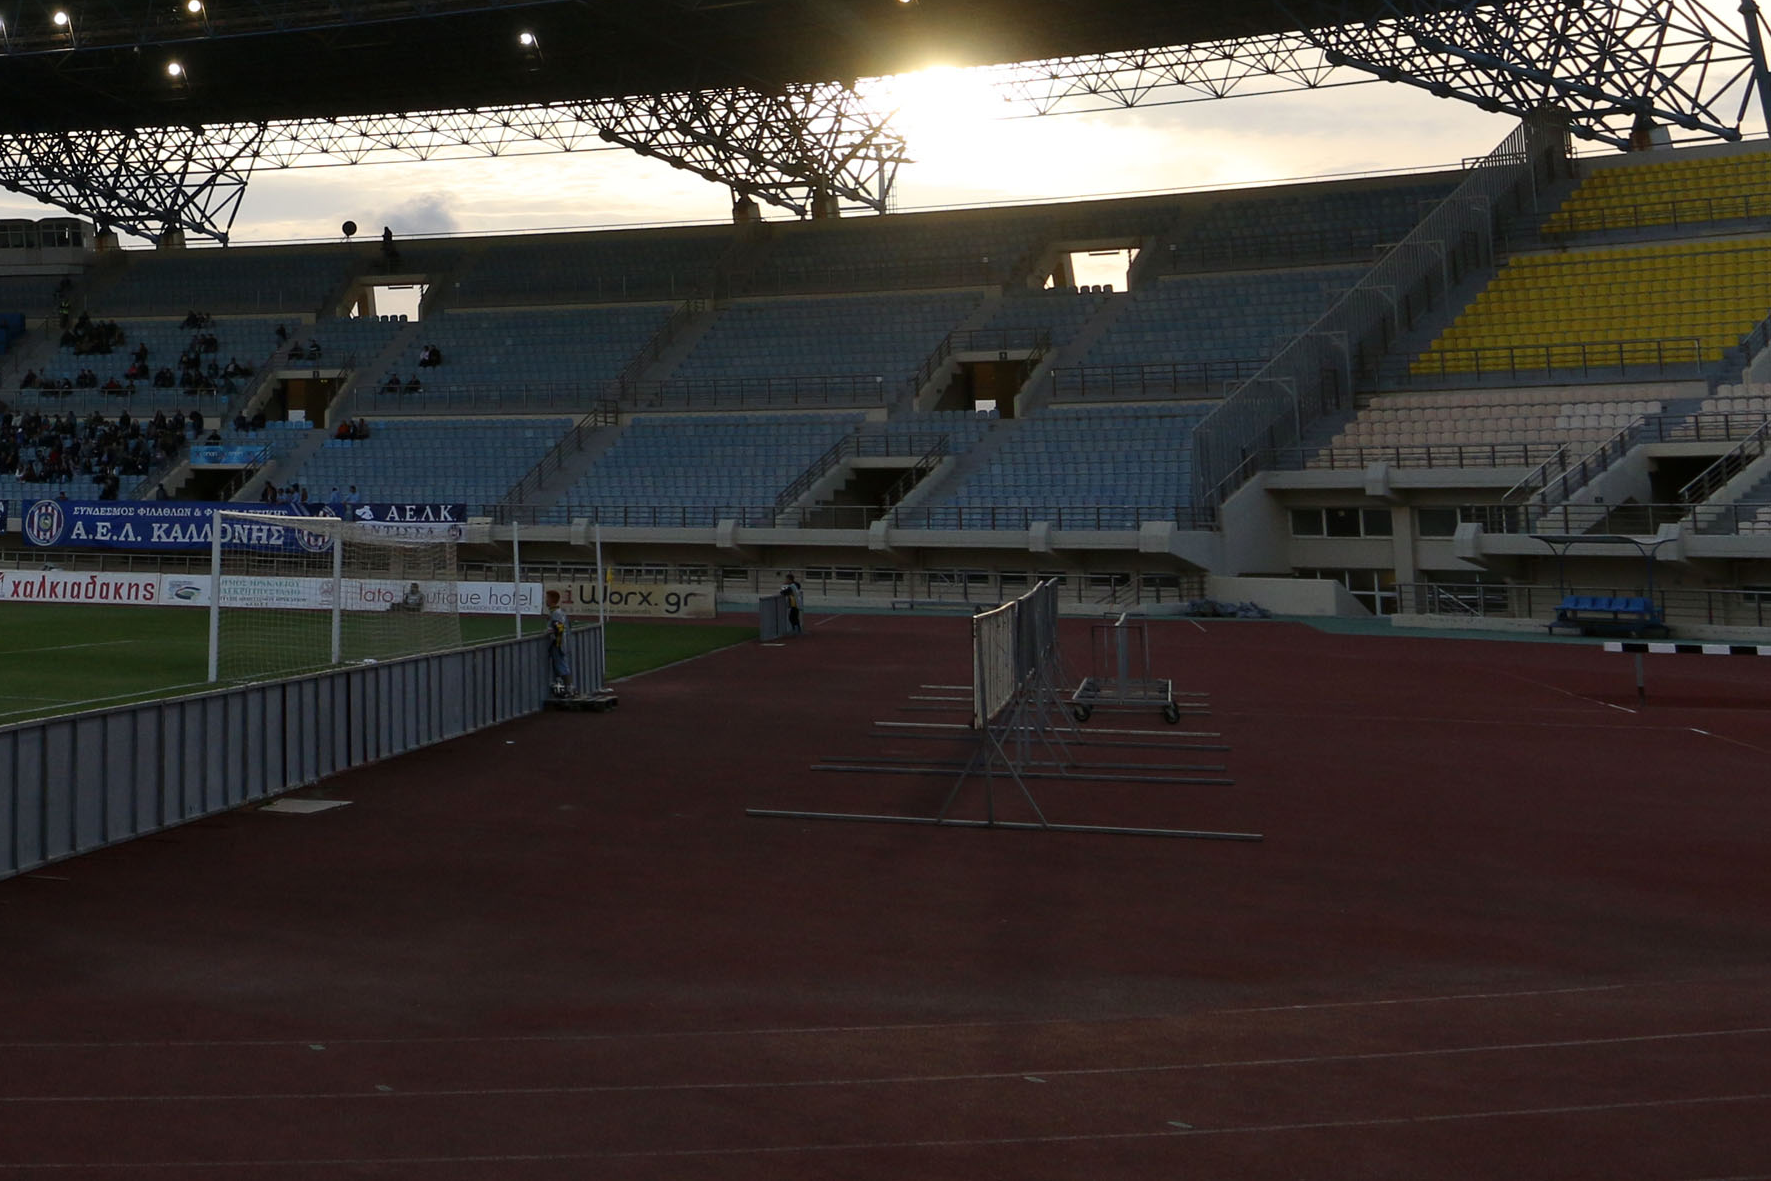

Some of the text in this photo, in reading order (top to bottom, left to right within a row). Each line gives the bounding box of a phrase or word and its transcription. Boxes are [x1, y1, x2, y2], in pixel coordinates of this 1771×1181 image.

[73, 506, 135, 516] ΣΥΝΔΕΣΜΟΣ
[137, 507, 191, 517] ΦΙΛΑΘΛΩΝ
[194, 508, 202, 517] &
[70, 520, 285, 545] Α.Ε.Λ. ΚΑΛΛΟΝΗΣ
[359, 582, 395, 603] lato
[488, 586, 533, 606] hotel
